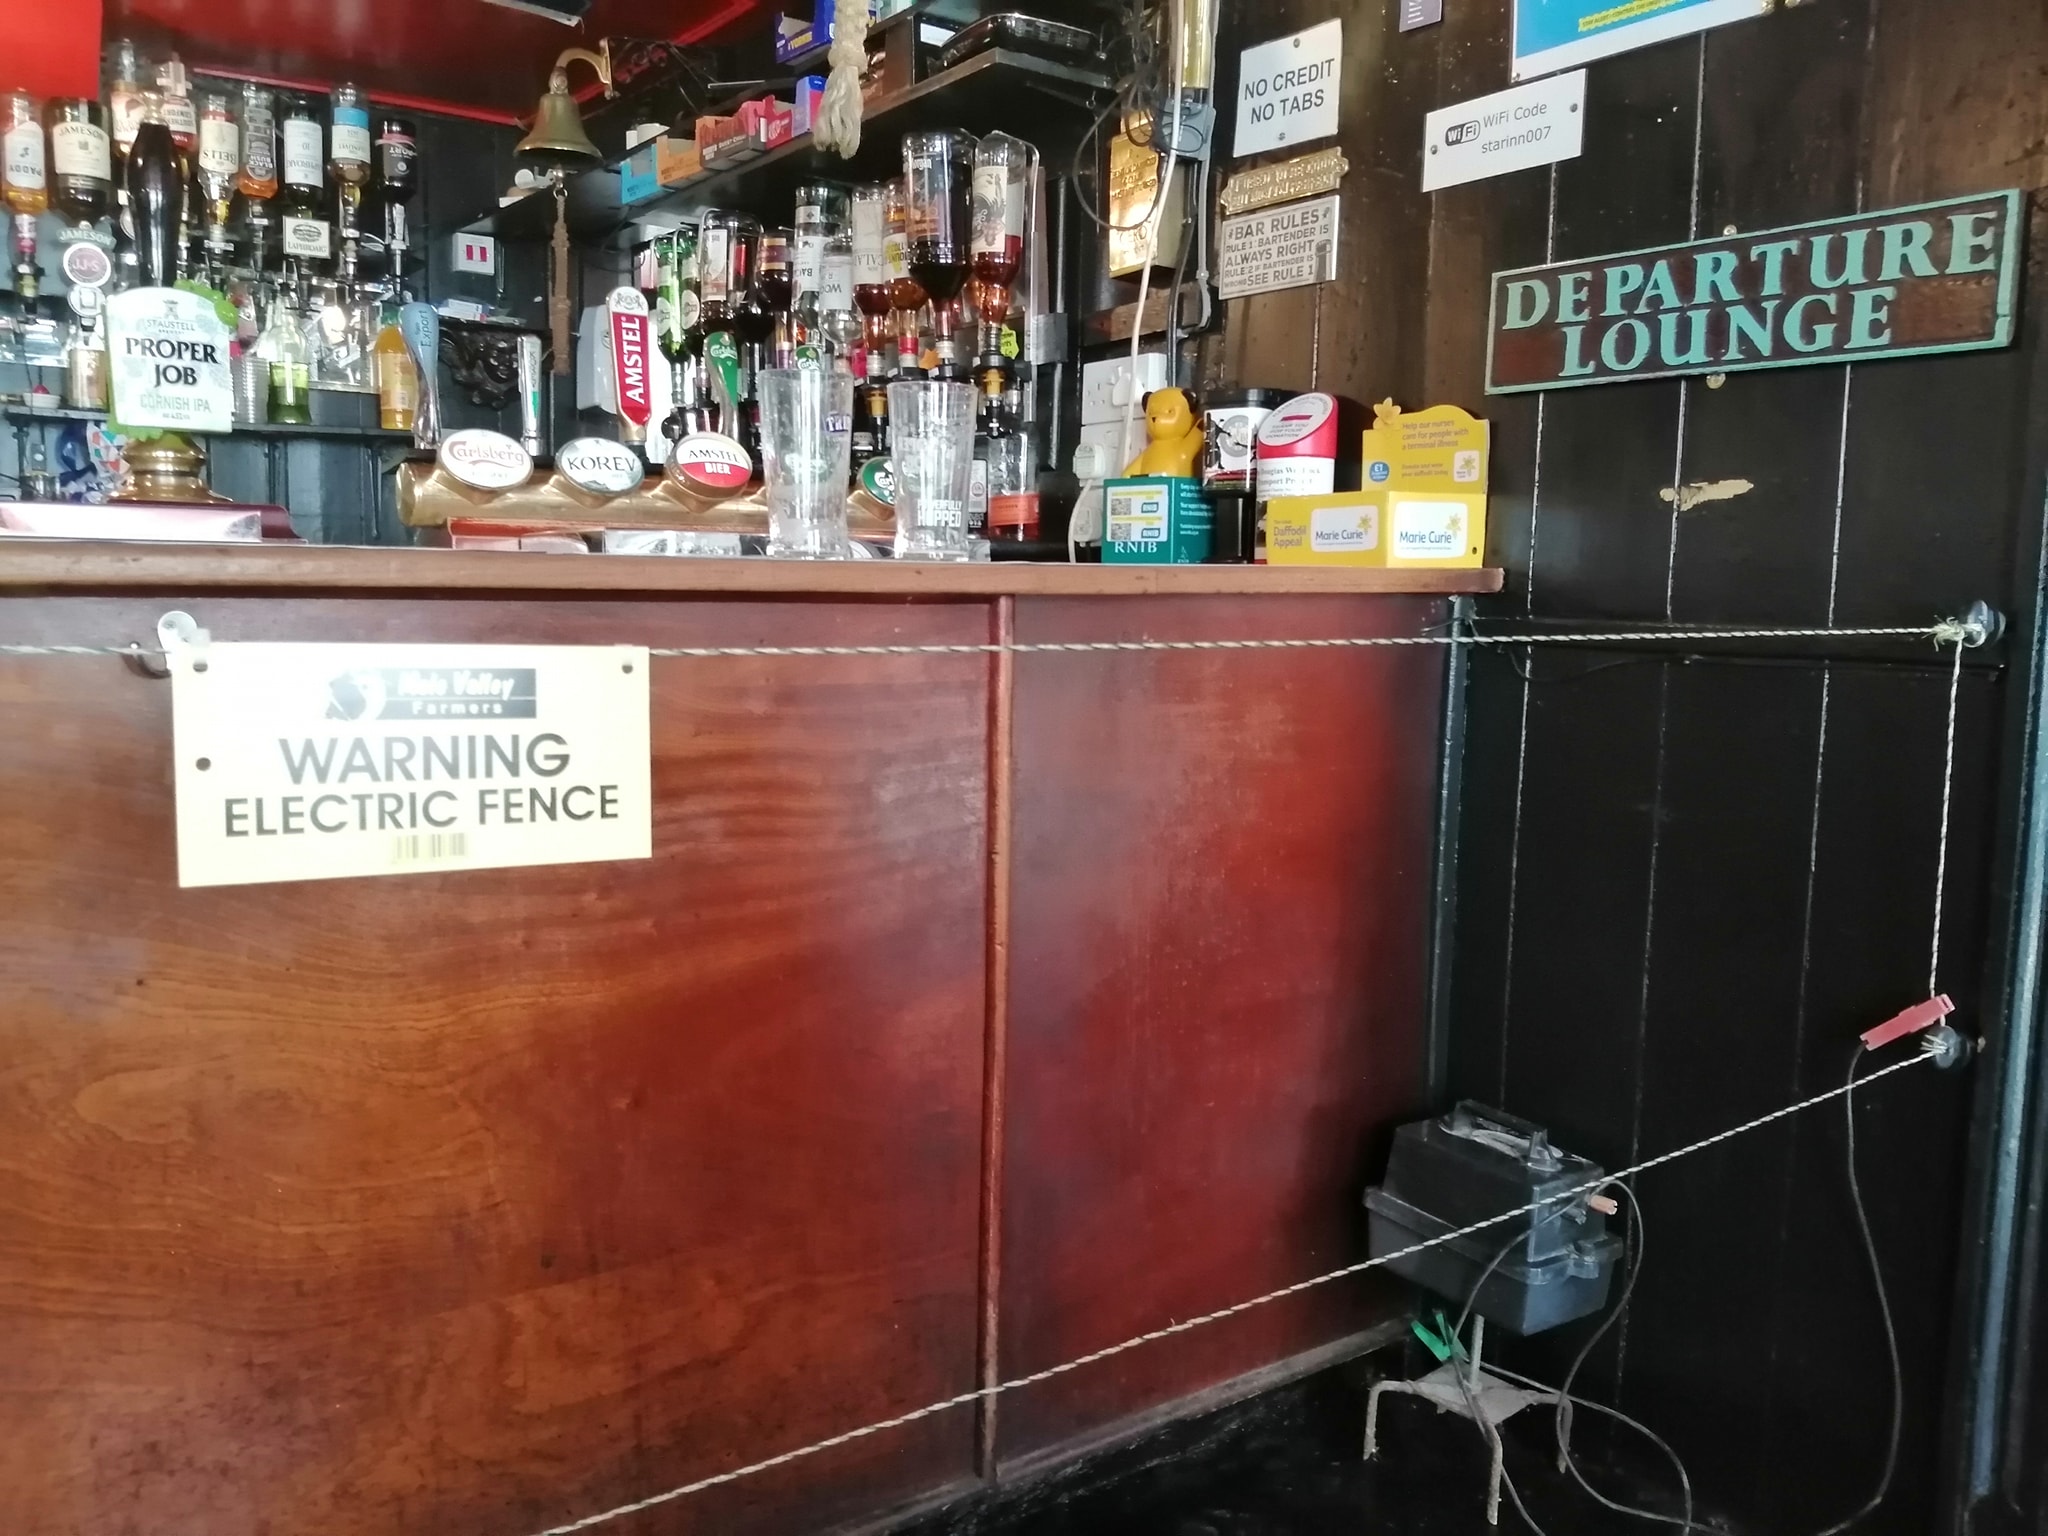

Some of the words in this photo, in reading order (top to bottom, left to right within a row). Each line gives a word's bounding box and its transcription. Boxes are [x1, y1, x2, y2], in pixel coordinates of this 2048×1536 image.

[1244, 79, 1268, 100] NO
[1273, 58, 1335, 92] CREDIT
[1251, 102, 1275, 125] NO
[1280, 89, 1325, 116] TABS
[1483, 110, 1510, 128] WiFi
[1514, 102, 1548, 120] Code
[1481, 126, 1552, 154] starinn007
[203, 150, 237, 165] BELL'S
[9, 164, 43, 177] PADDY
[1235, 222, 1265, 241] BAR
[1271, 209, 1319, 233] RULES
[60, 230, 110, 246] JAMESON
[1226, 242, 1247, 254] RULE
[1258, 227, 1316, 247] BARTENDER
[1319, 224, 1329, 234] IS
[1225, 248, 1273, 268] ALWAYS
[1277, 240, 1314, 258] RIGHT
[1263, 256, 1304, 270] BARTENDER
[1247, 273, 1269, 287] SEE
[1273, 267, 1304, 282] RULE
[1308, 264, 1314, 275] 1
[1502, 209, 2000, 330] DEPARTURE
[158, 321, 196, 332] AUSTELL
[418, 310, 433, 347] Export
[1558, 286, 1899, 377] LOUNGE
[125, 337, 222, 365] PROPER
[622, 316, 644, 404] AMSTEL
[154, 364, 198, 388] JOB
[140, 394, 190, 411] CORNISH
[194, 398, 212, 413] IPA
[1403, 422, 1417, 432] Help
[1432, 420, 1455, 428] nurses
[1418, 431, 1428, 439] for
[1429, 429, 1451, 440] people
[1454, 427, 1469, 436] with
[449, 440, 524, 466] Carlsberg
[1407, 440, 1436, 450] terminal
[567, 456, 636, 473] KOREV
[688, 449, 741, 464] AMSTEL
[703, 463, 731, 475] BIER
[1273, 525, 1307, 536] Daffodil
[1315, 531, 1340, 542] Marie
[1341, 529, 1363, 541] Curie
[1400, 531, 1427, 543] Marie
[1428, 531, 1452, 544] Curie
[1114, 541, 1158, 554] RNIB
[1273, 537, 1303, 550] Appeal
[453, 669, 515, 701] Valley
[412, 701, 503, 715] Farmers
[278, 732, 572, 785] WARNING
[224, 790, 459, 838] ELECTRIC
[478, 784, 619, 825] FENCE
